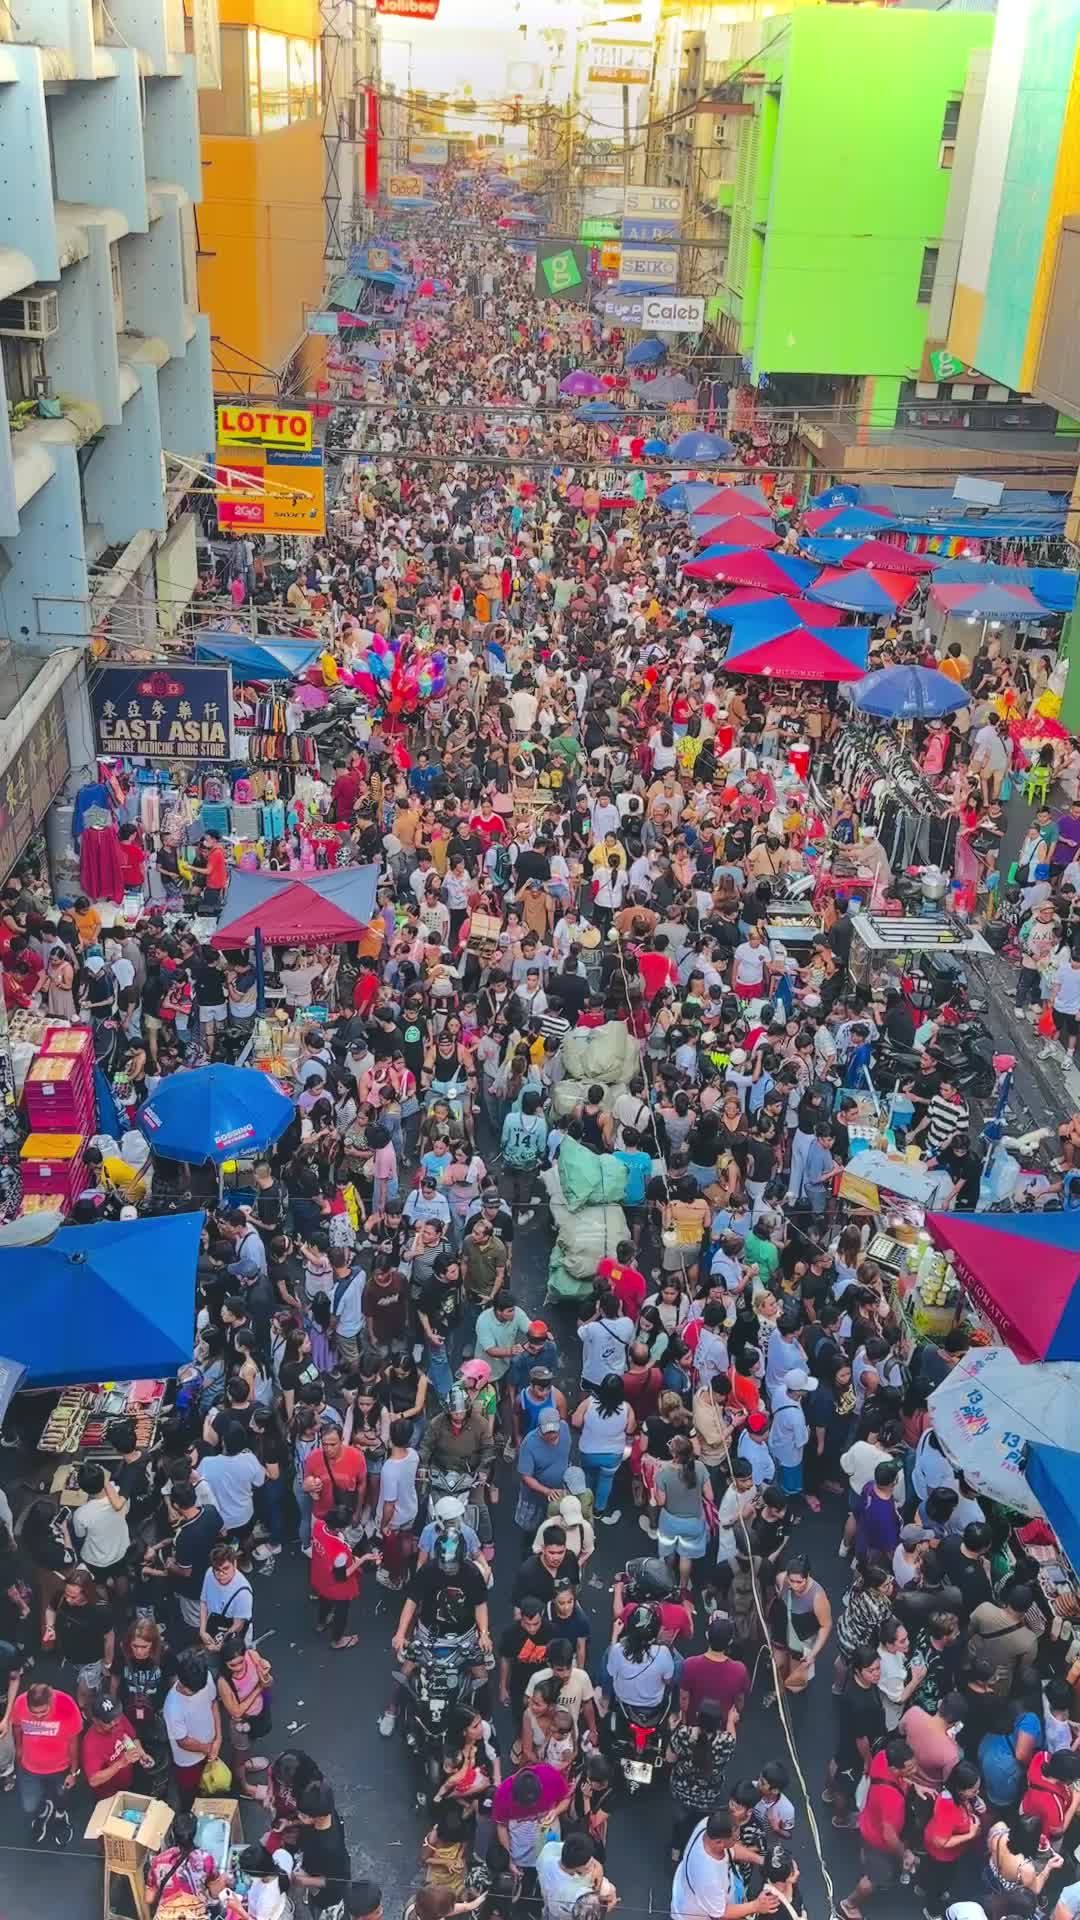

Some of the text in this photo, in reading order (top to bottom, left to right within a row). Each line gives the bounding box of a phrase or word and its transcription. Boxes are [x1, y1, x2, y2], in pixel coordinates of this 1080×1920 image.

[627, 196, 679, 209] SIKO
[623, 260, 673, 272] SEIKO
[647, 302, 700, 319] Caleb
[222, 411, 307, 436] LOTTO
[234, 505, 261, 517] 2GO
[100, 719, 226, 742] EAST ASIA
[103, 740, 225, 756] CHINESE MEDICINE DRUG STORE
[264, 932, 336, 944] MICROMATIC
[515, 1133, 531, 1148] 14
[966, 1388, 983, 1404] 13
[1001, 1431, 1021, 1449] 13
